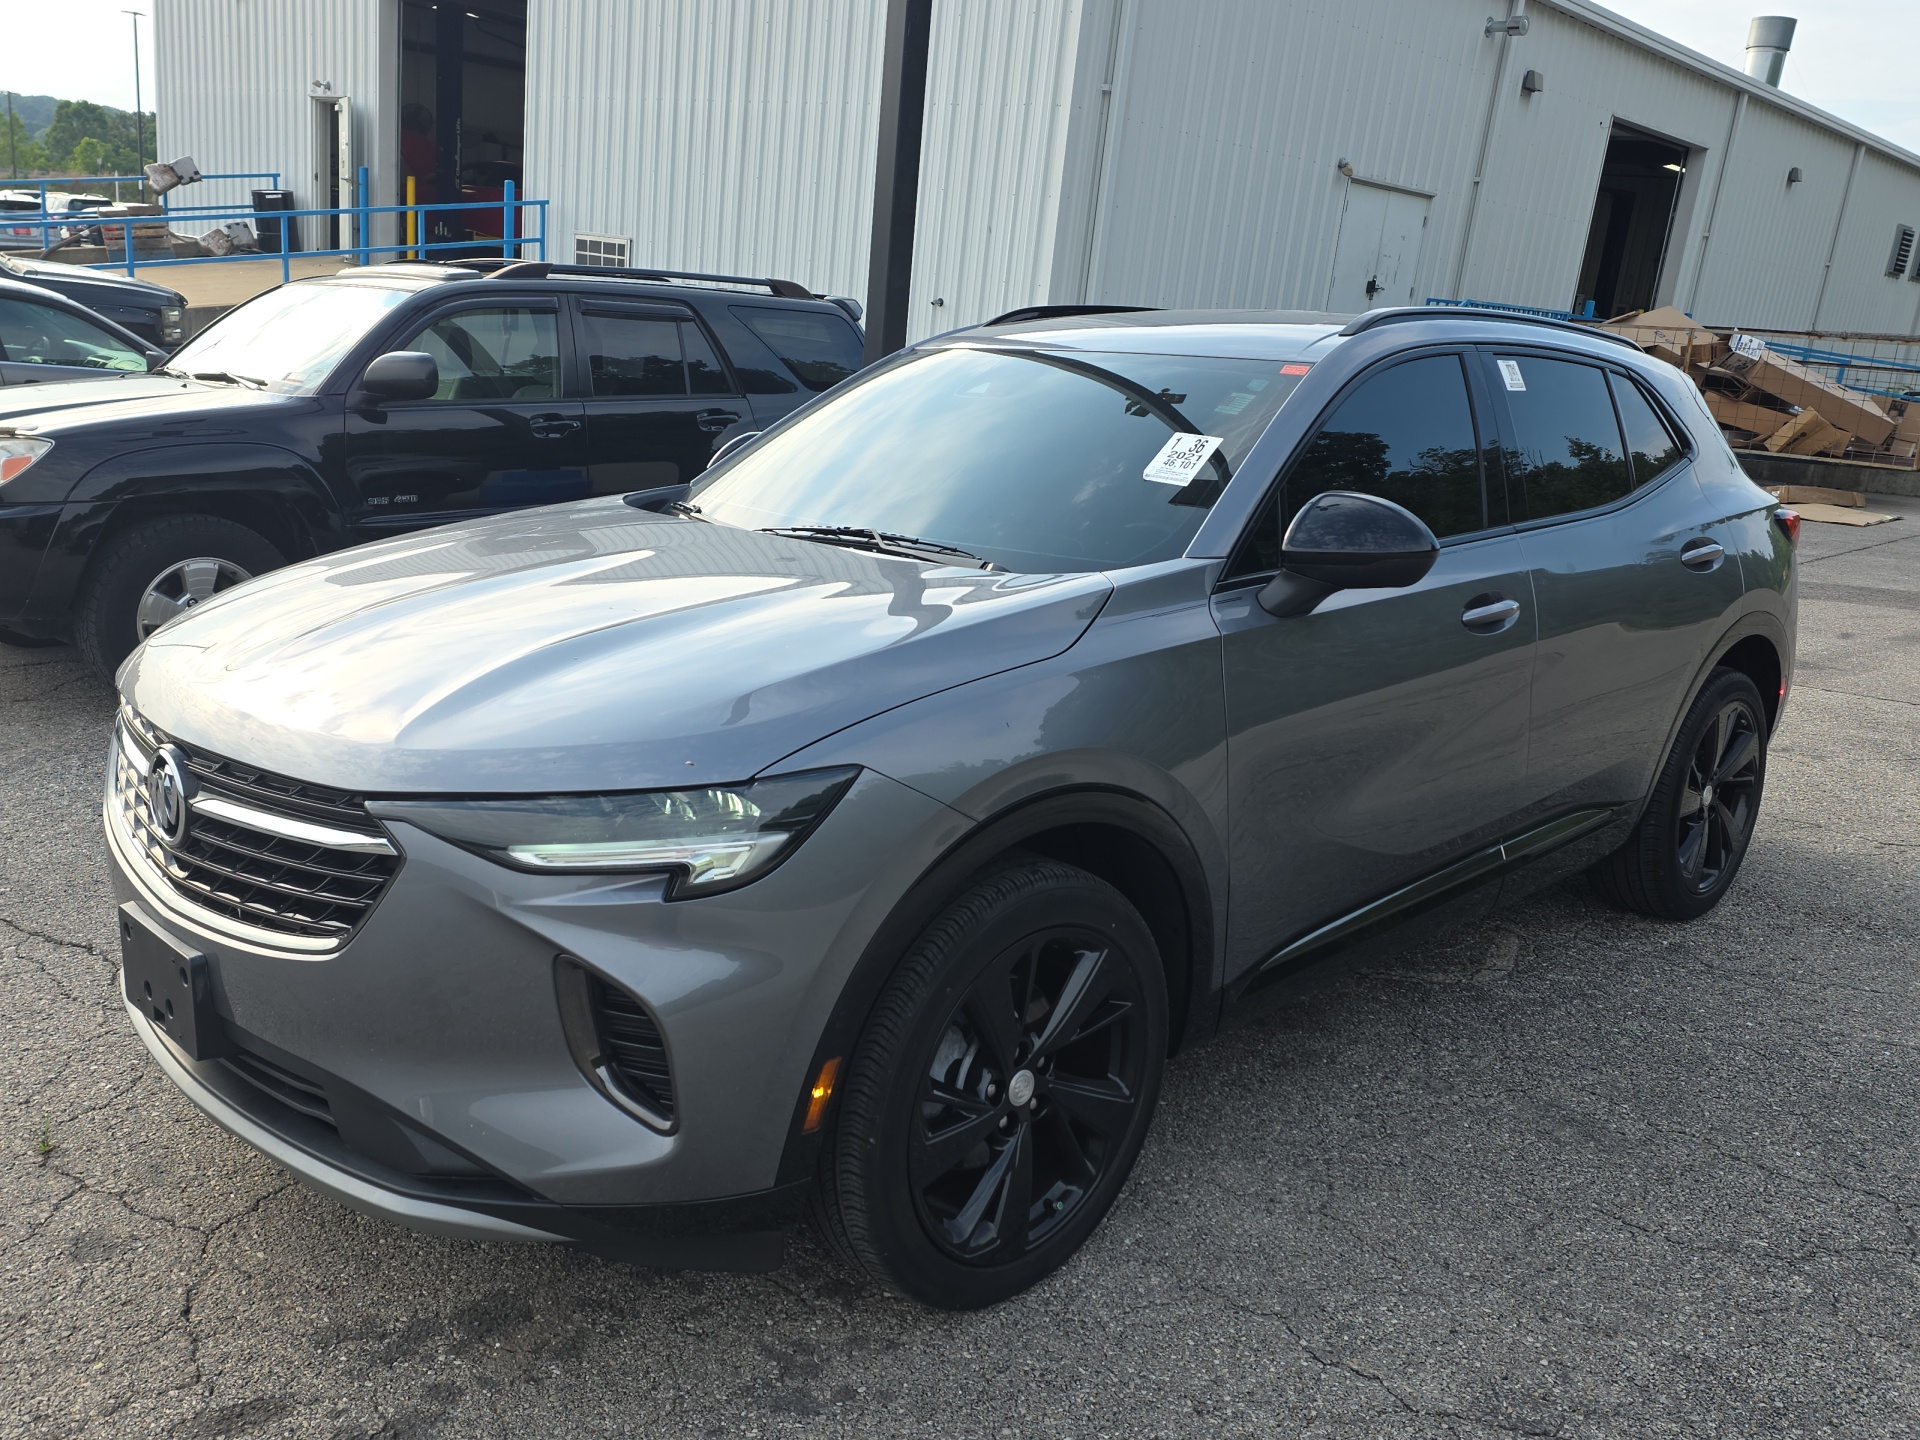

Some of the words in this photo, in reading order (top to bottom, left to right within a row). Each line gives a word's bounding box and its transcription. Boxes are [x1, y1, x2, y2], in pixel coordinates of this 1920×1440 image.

[1171, 436, 1183, 450] 1
[1188, 439, 1209, 454] 36
[1167, 451, 1203, 462] 2021
[1163, 458, 1197, 470] 46,101
